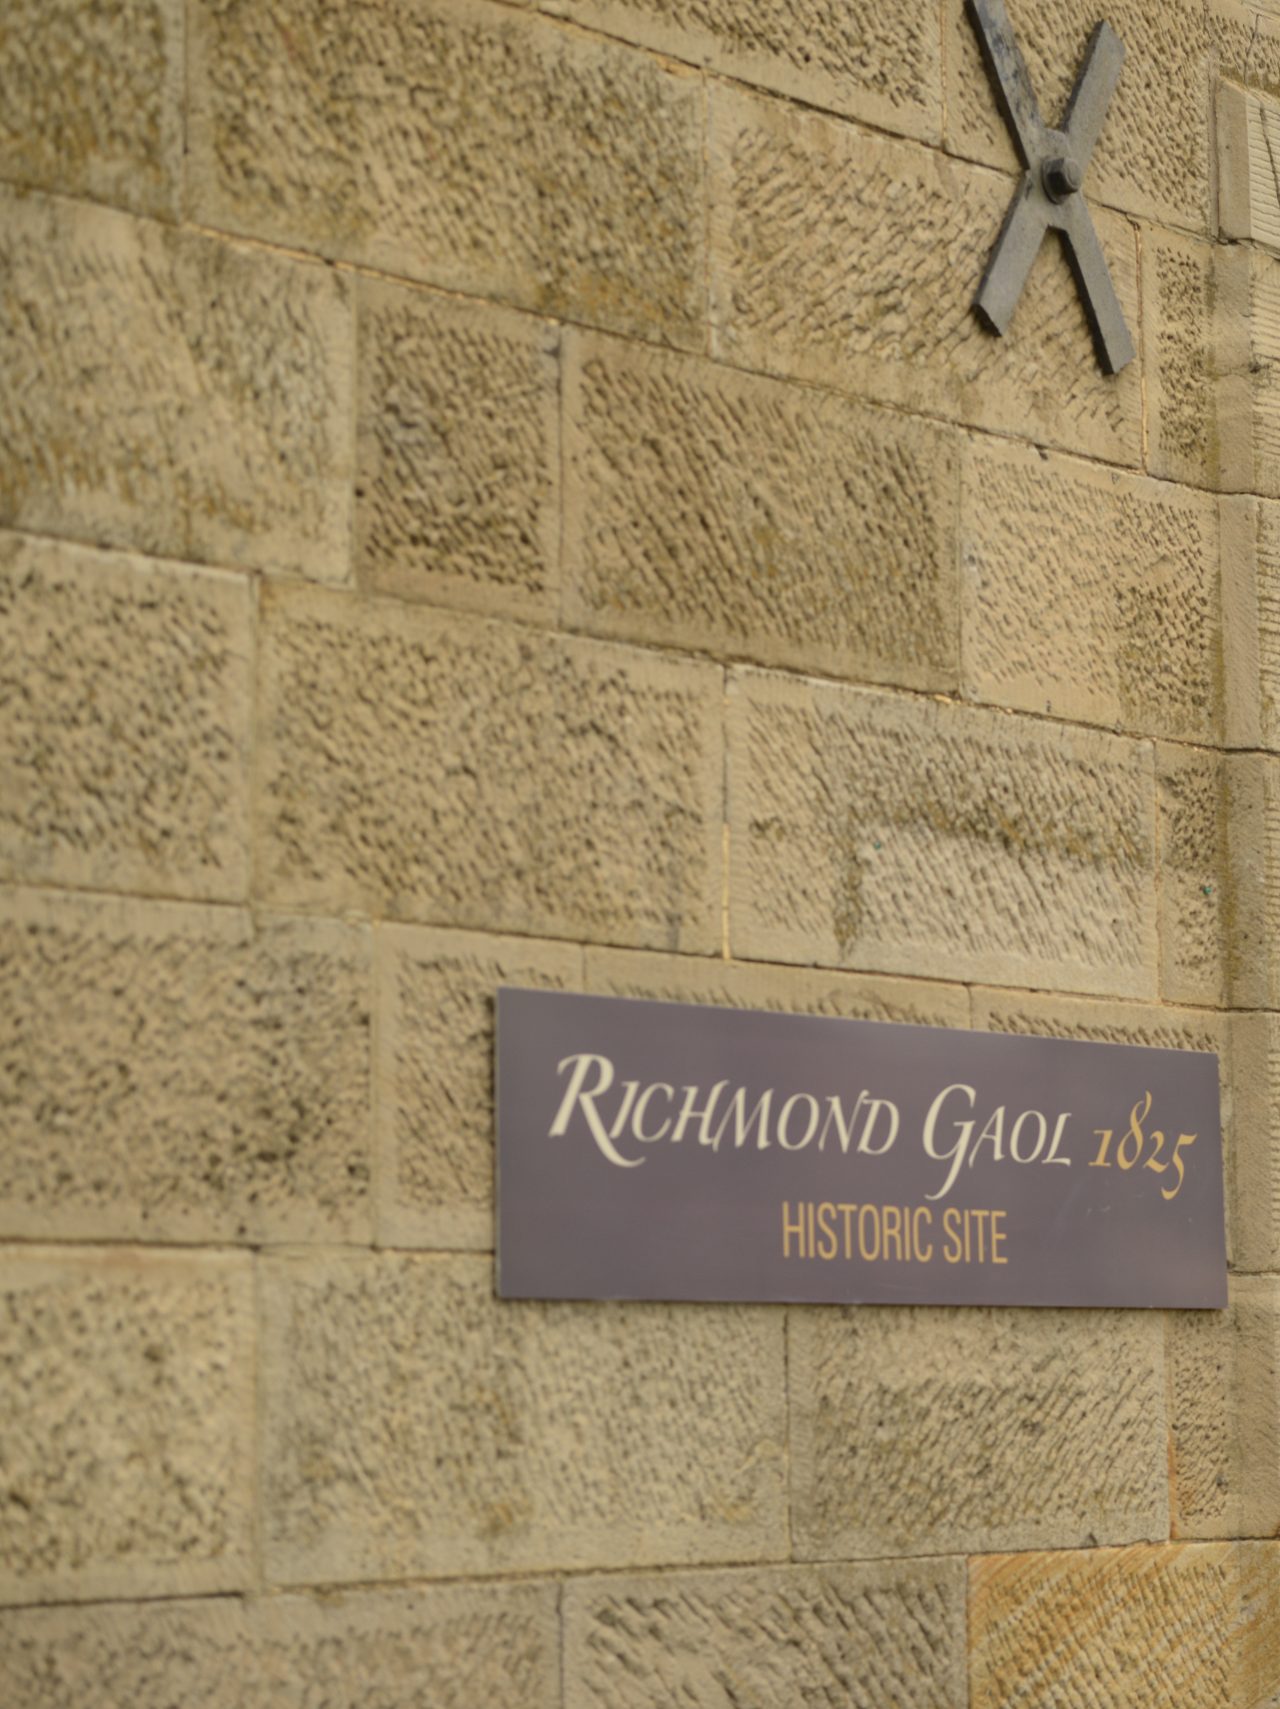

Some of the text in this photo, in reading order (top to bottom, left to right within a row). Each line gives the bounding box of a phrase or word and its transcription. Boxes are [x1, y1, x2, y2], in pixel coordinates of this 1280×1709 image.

[548, 1053, 1198, 1201] RICHMOND GAOL 1825
[782, 1201, 1008, 1264] HISTORIC SITE
